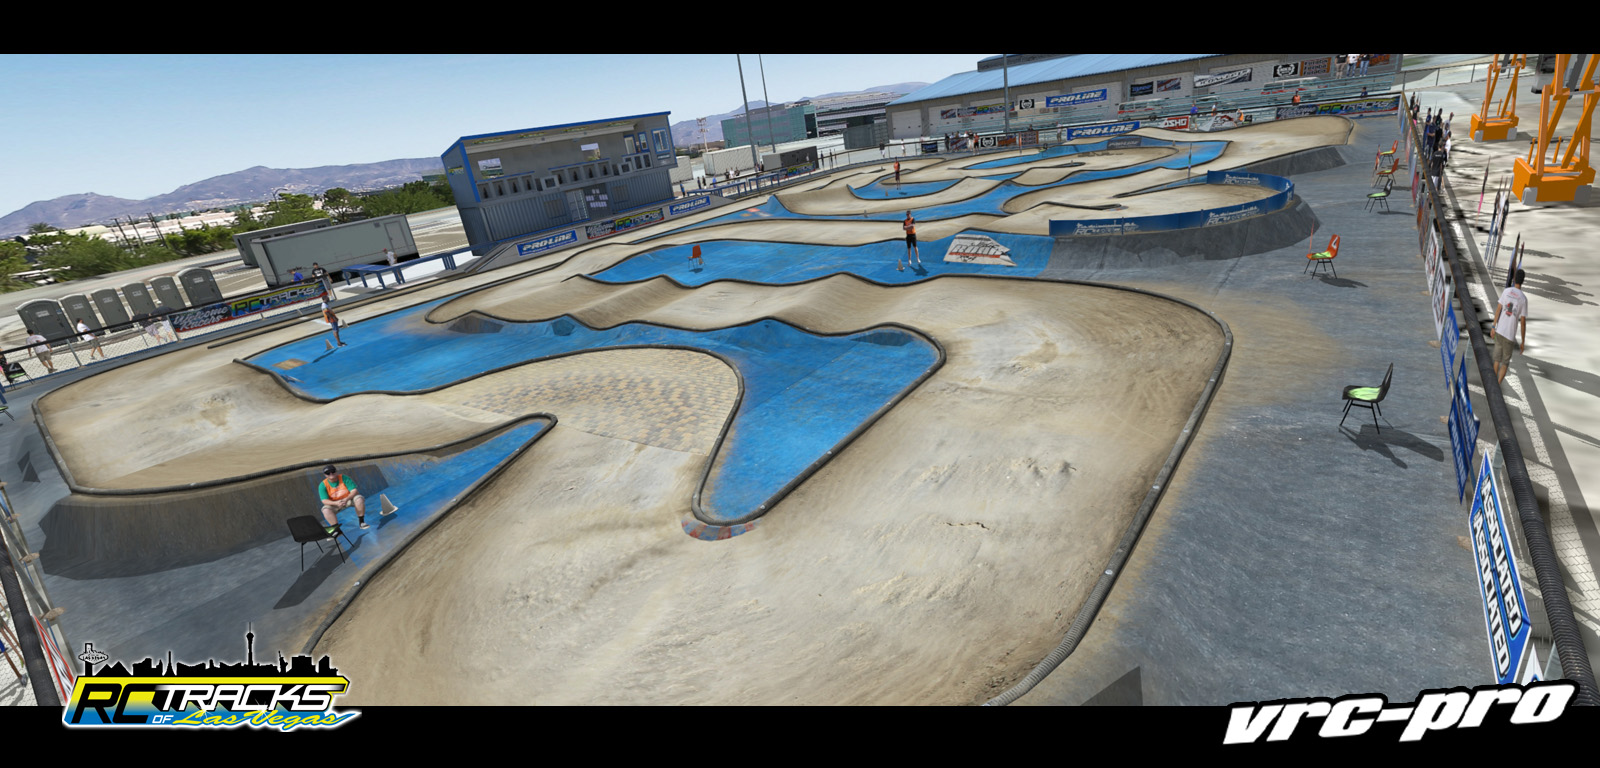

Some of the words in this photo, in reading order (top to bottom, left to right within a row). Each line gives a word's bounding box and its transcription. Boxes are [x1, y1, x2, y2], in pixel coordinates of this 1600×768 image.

[173, 306, 229, 325] Welcome
[1473, 512, 1510, 675] ASSOCIATED
[1481, 476, 1521, 635] ASSOCIATED
